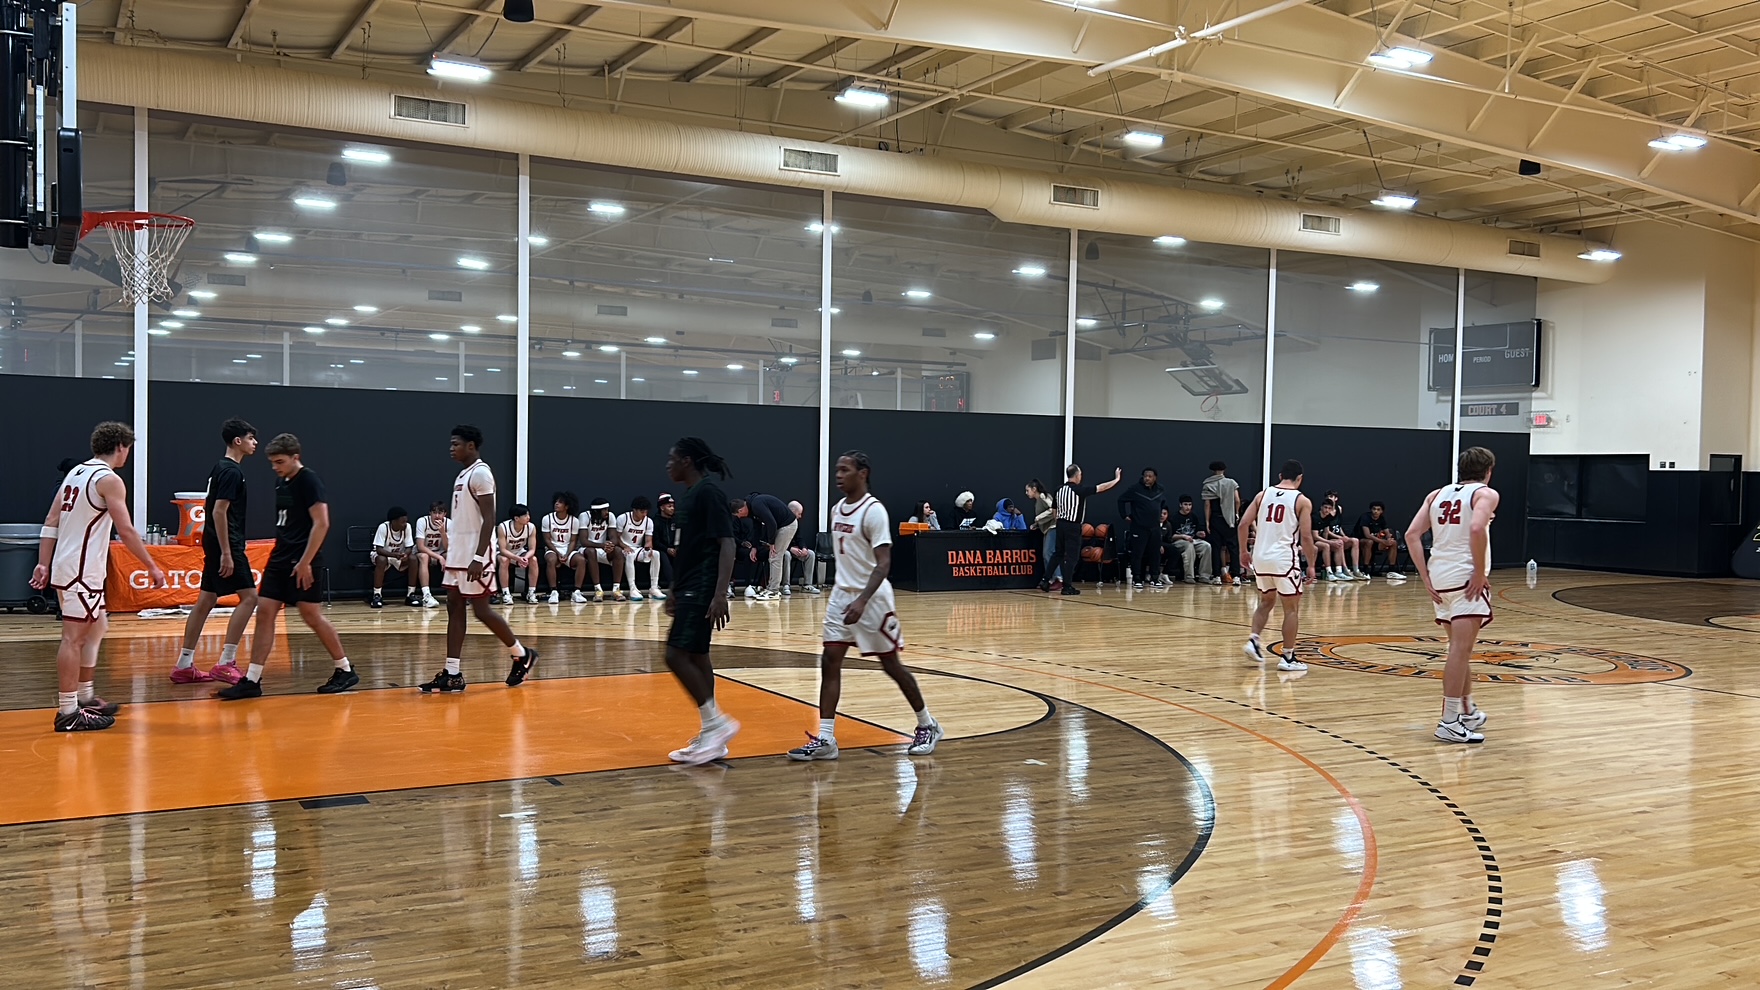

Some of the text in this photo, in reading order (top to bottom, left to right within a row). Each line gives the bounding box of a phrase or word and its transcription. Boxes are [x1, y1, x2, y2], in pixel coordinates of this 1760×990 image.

[1438, 353, 1454, 363] HOM
[1472, 355, 1492, 363] PERIOD
[1504, 348, 1530, 359] GUEST
[1467, 404, 1507, 416] COURT 4
[1265, 503, 1286, 524] 10
[1437, 499, 1462, 525] 32
[427, 540, 439, 548] 24
[556, 534, 565, 543] 11
[631, 535, 638, 543] 4
[838, 536, 845, 554] 1
[947, 549, 1036, 565] DANA BARROS
[952, 564, 1033, 577] BASKETBALL CLUB
